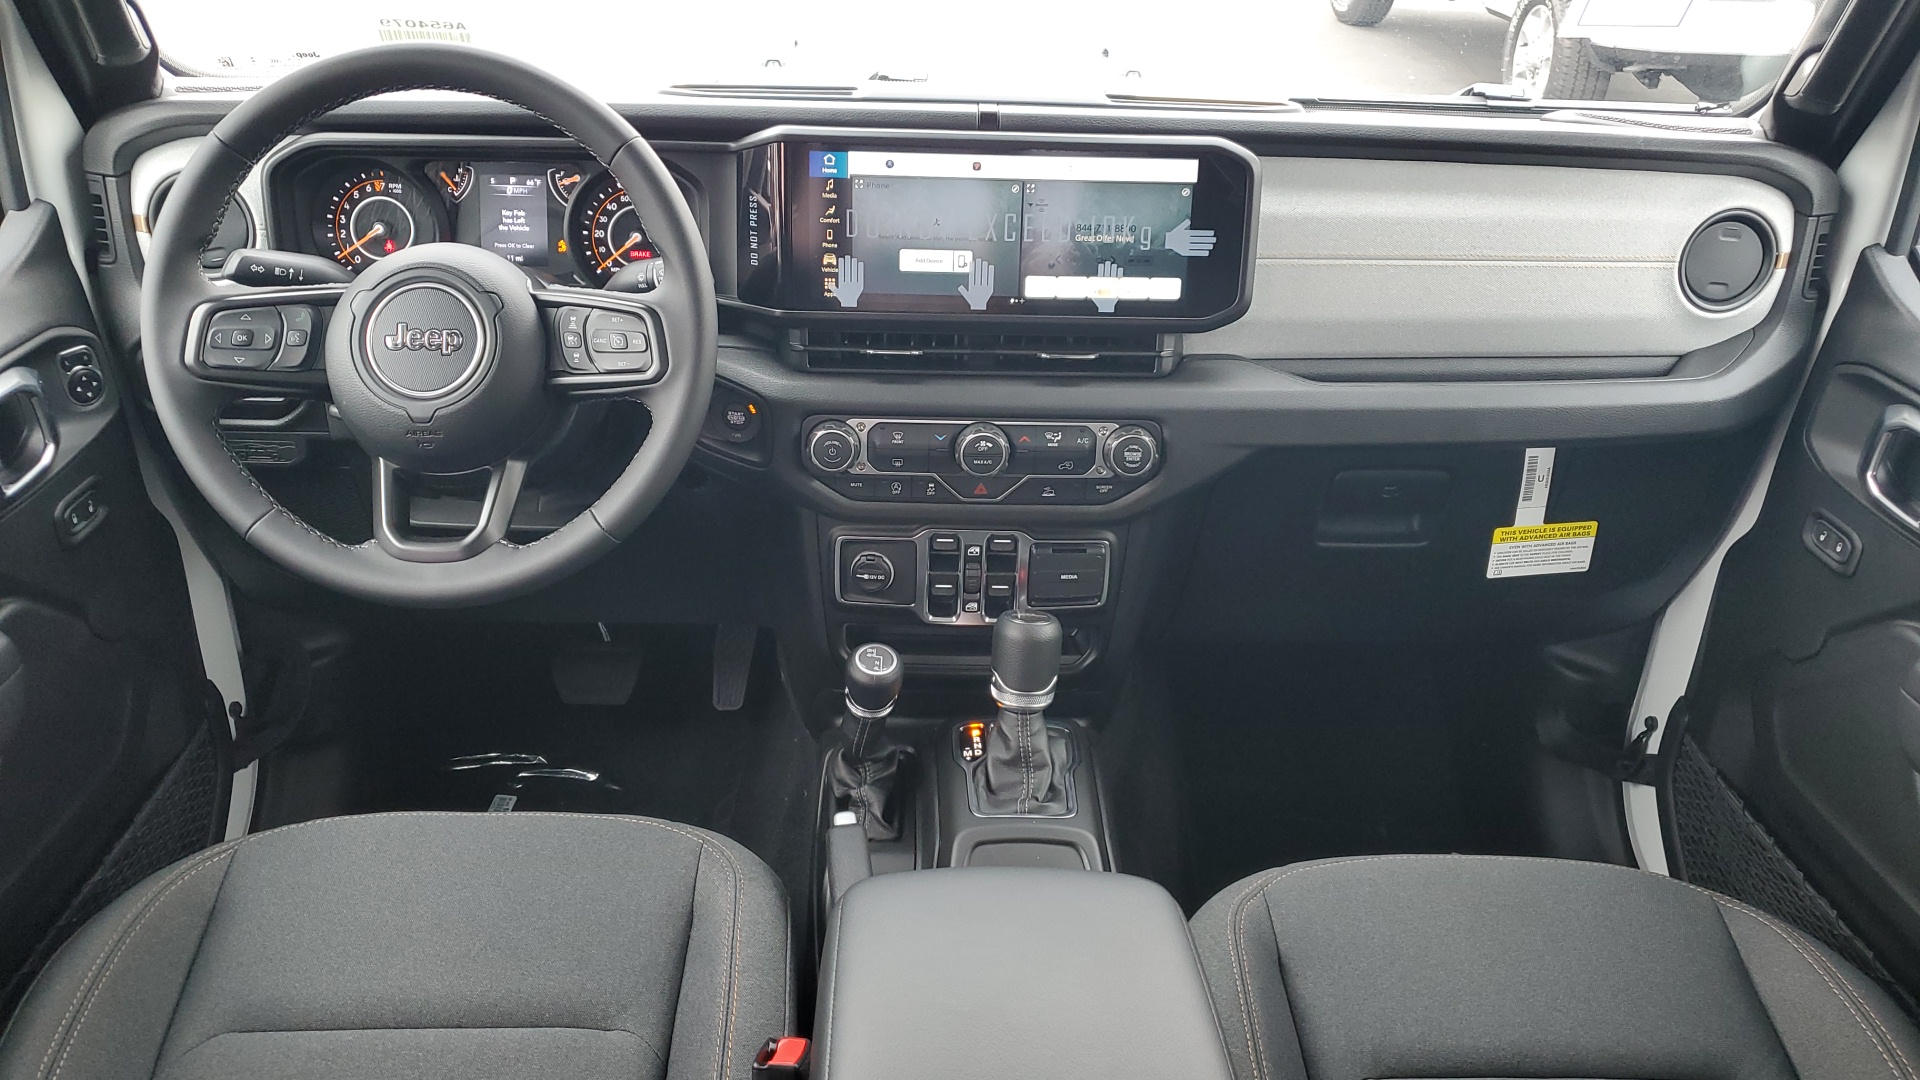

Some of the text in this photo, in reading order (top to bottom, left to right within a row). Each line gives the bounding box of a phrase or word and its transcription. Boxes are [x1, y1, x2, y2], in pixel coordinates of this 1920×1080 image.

[366, 184, 372, 192] 6
[354, 191, 359, 199] 5
[344, 201, 350, 210] 4
[502, 209, 512, 217] Key
[340, 215, 346, 223] 3
[340, 230, 346, 238] 2
[749, 195, 759, 266] DO NOT PRESS
[355, 255, 361, 263] 0
[384, 322, 464, 356] Jeep
